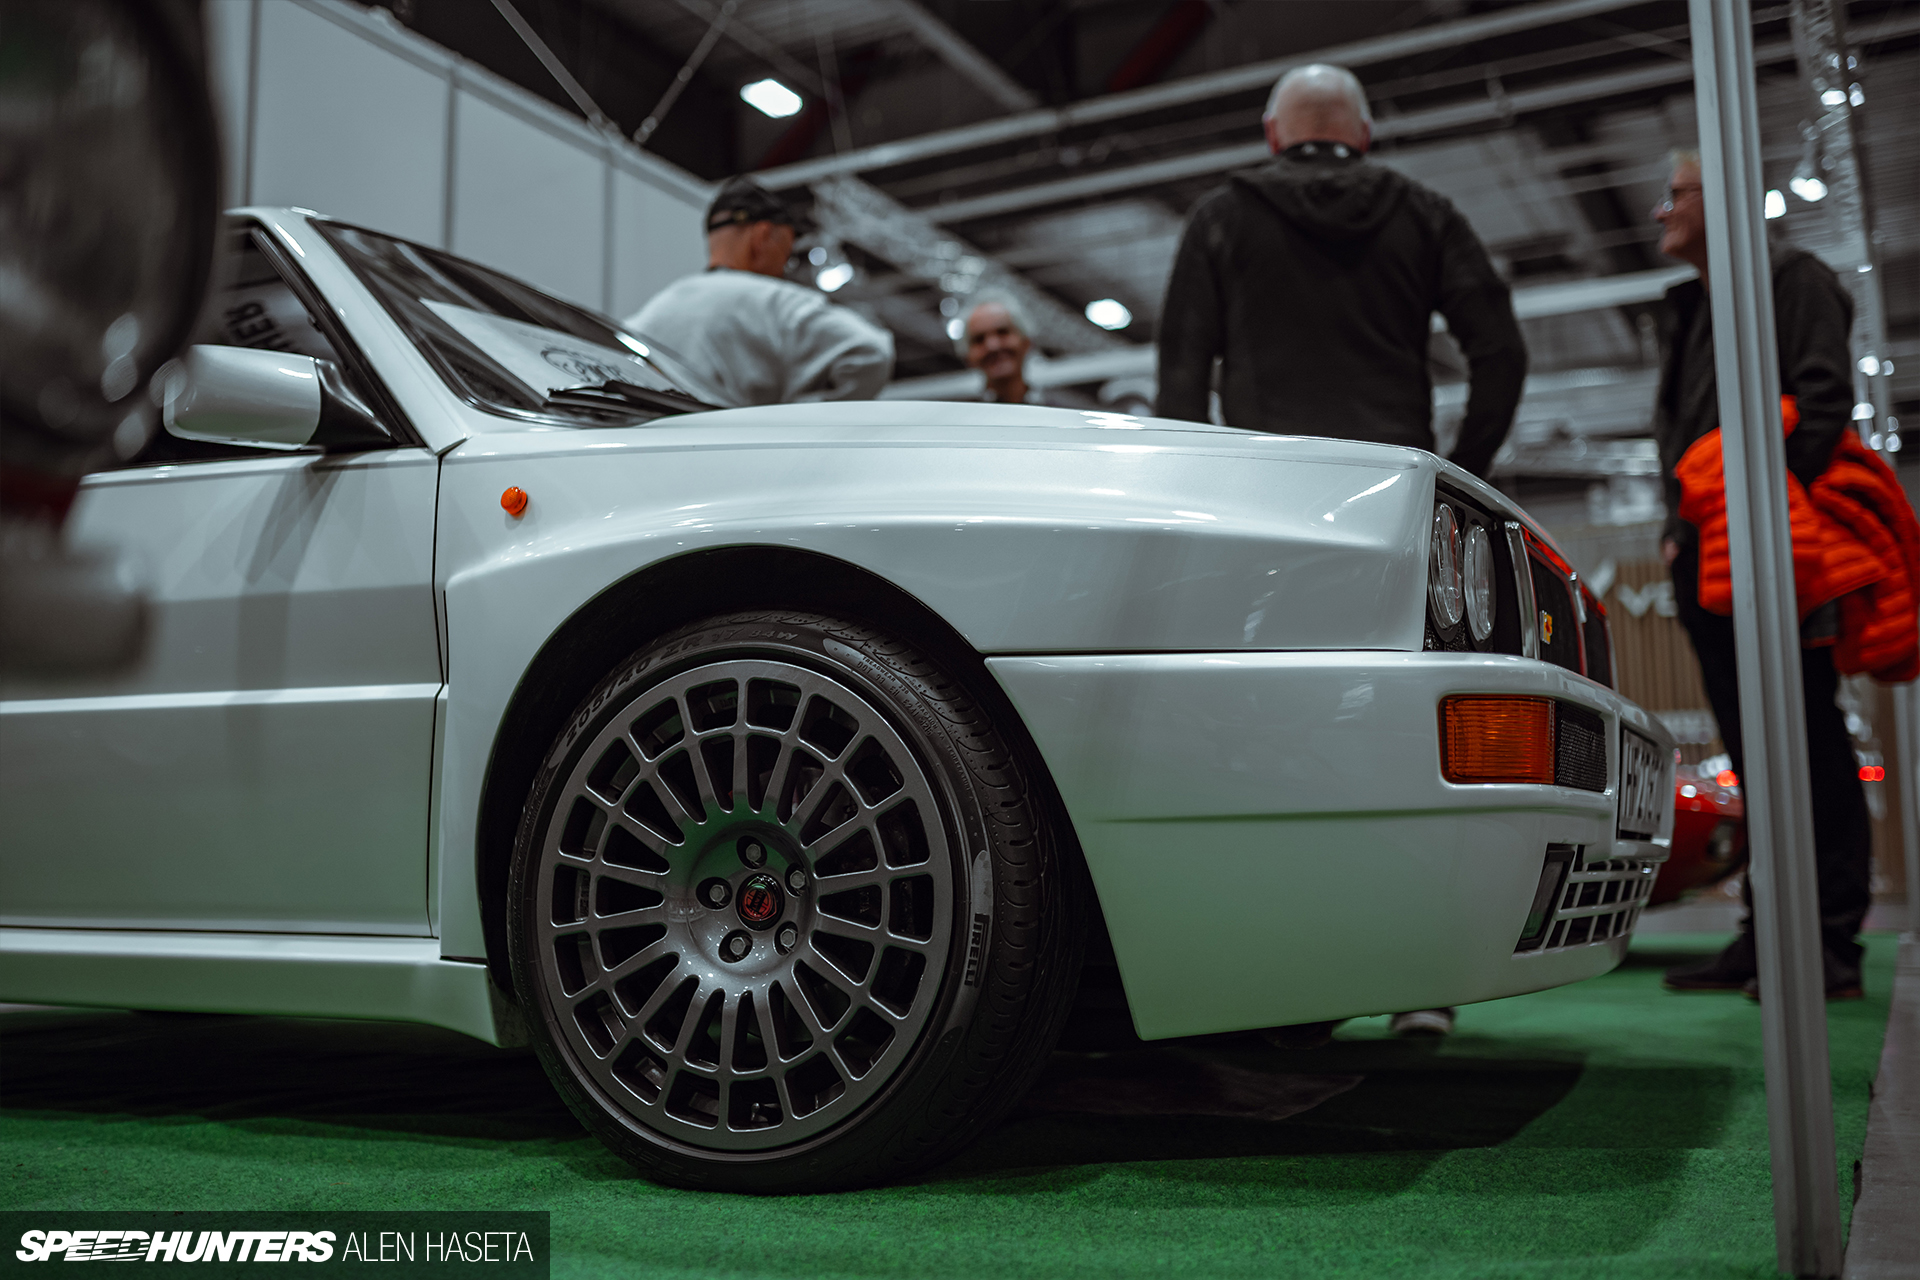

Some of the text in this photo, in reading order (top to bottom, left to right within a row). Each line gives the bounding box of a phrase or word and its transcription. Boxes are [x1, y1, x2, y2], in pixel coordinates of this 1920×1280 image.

[566, 660, 649, 747] 205/40
[862, 656, 896, 682] TREADWEAR
[914, 700, 938, 729] TRACTION
[964, 913, 990, 988] PIRELLI
